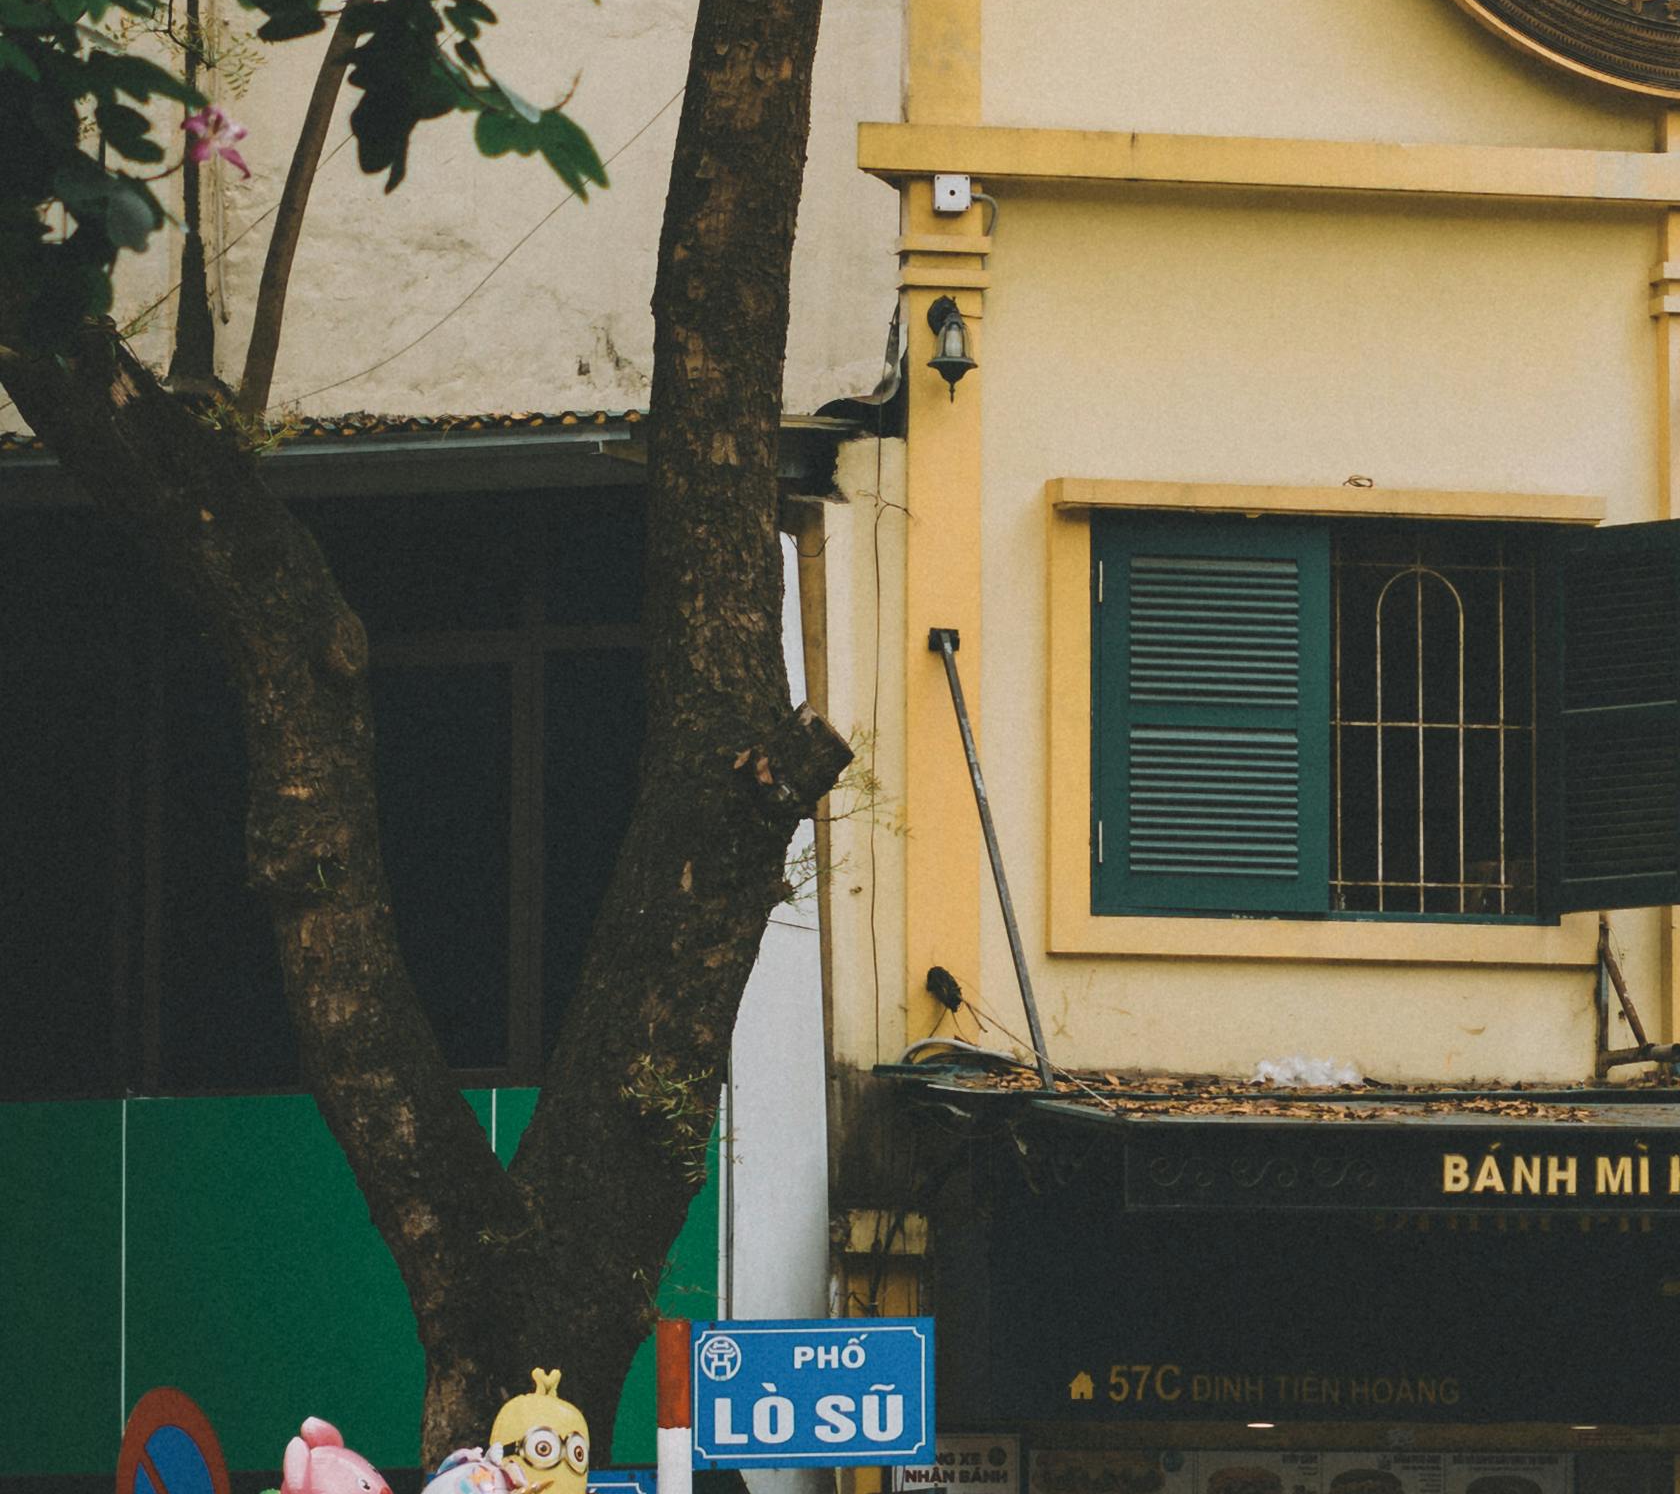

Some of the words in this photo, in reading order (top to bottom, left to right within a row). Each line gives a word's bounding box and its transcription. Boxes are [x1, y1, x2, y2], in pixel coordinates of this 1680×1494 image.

[1443, 1141, 1578, 1196] BÁNH
[1595, 1140, 1651, 1196] MÌ
[793, 1333, 869, 1370] PHỐ
[1108, 1364, 1182, 1402] 57C
[714, 1382, 795, 1445] LÒ
[814, 1383, 905, 1444] SŨ
[904, 1466, 955, 1488] NHẬN
